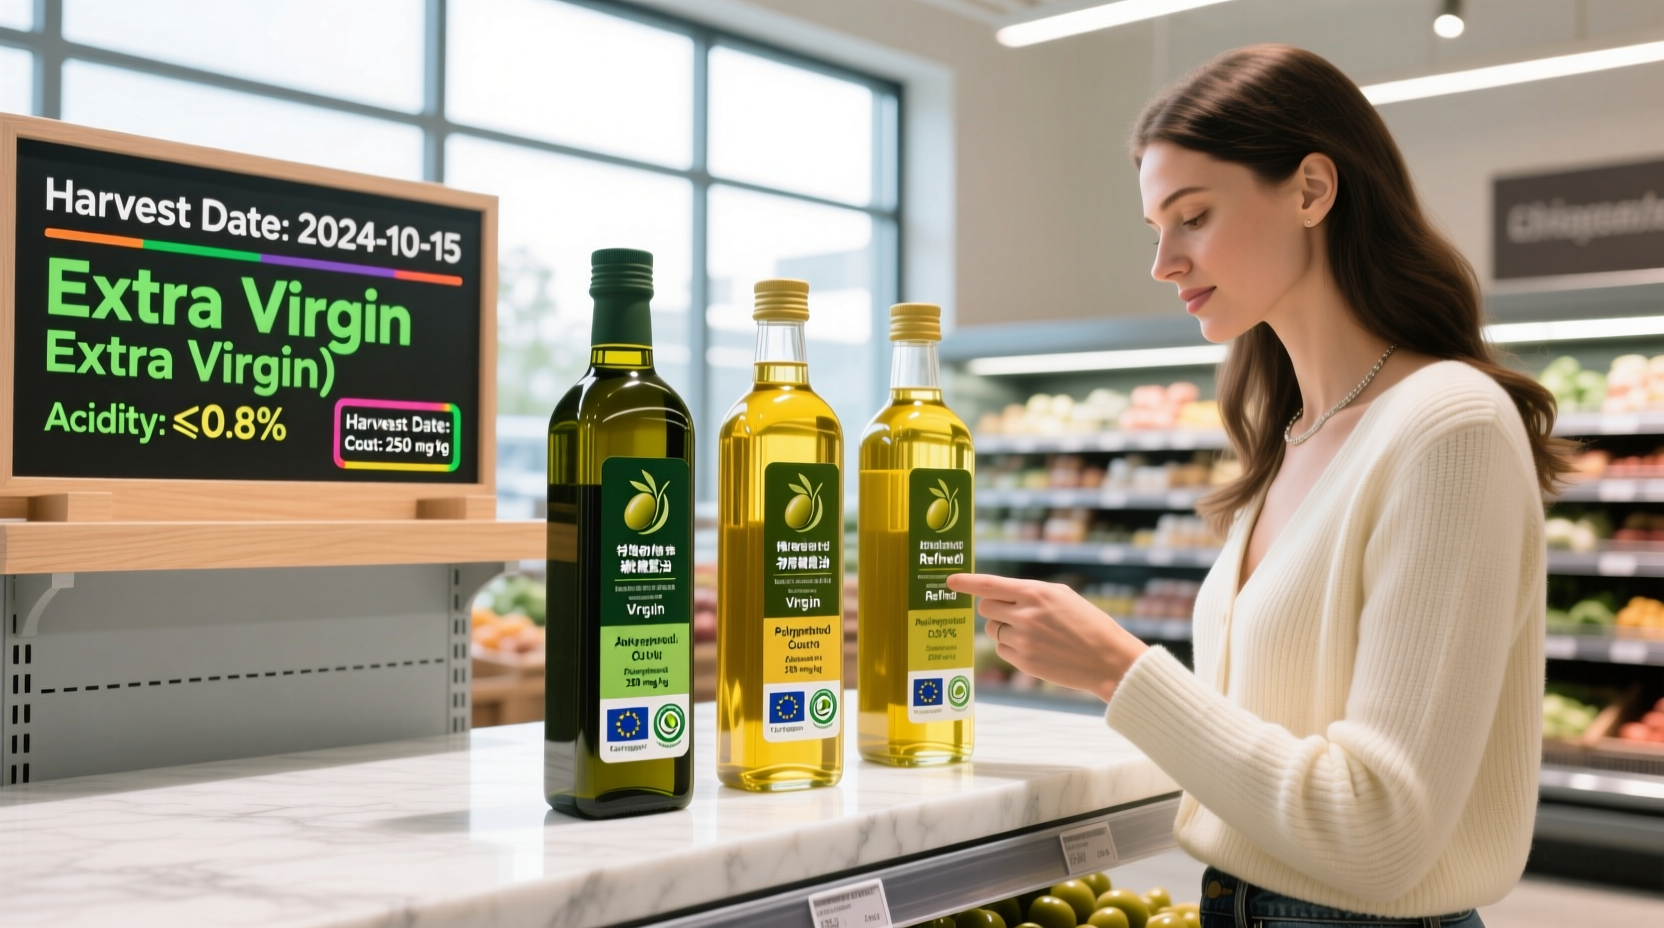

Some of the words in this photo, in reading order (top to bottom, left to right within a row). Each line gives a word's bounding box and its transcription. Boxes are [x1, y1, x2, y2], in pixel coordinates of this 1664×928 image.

[46, 177, 192, 229] Harvest
[202, 198, 290, 242] Date:
[298, 212, 462, 264] 2024-10-15
[48, 258, 222, 329] Extra
[242, 277, 411, 355] Virgin
[47, 330, 173, 380] Extra
[188, 340, 335, 398] Virgin)
[44, 402, 166, 444] Acidity:
[385, 437, 412, 453] 250
[412, 415, 451, 433] Date:
